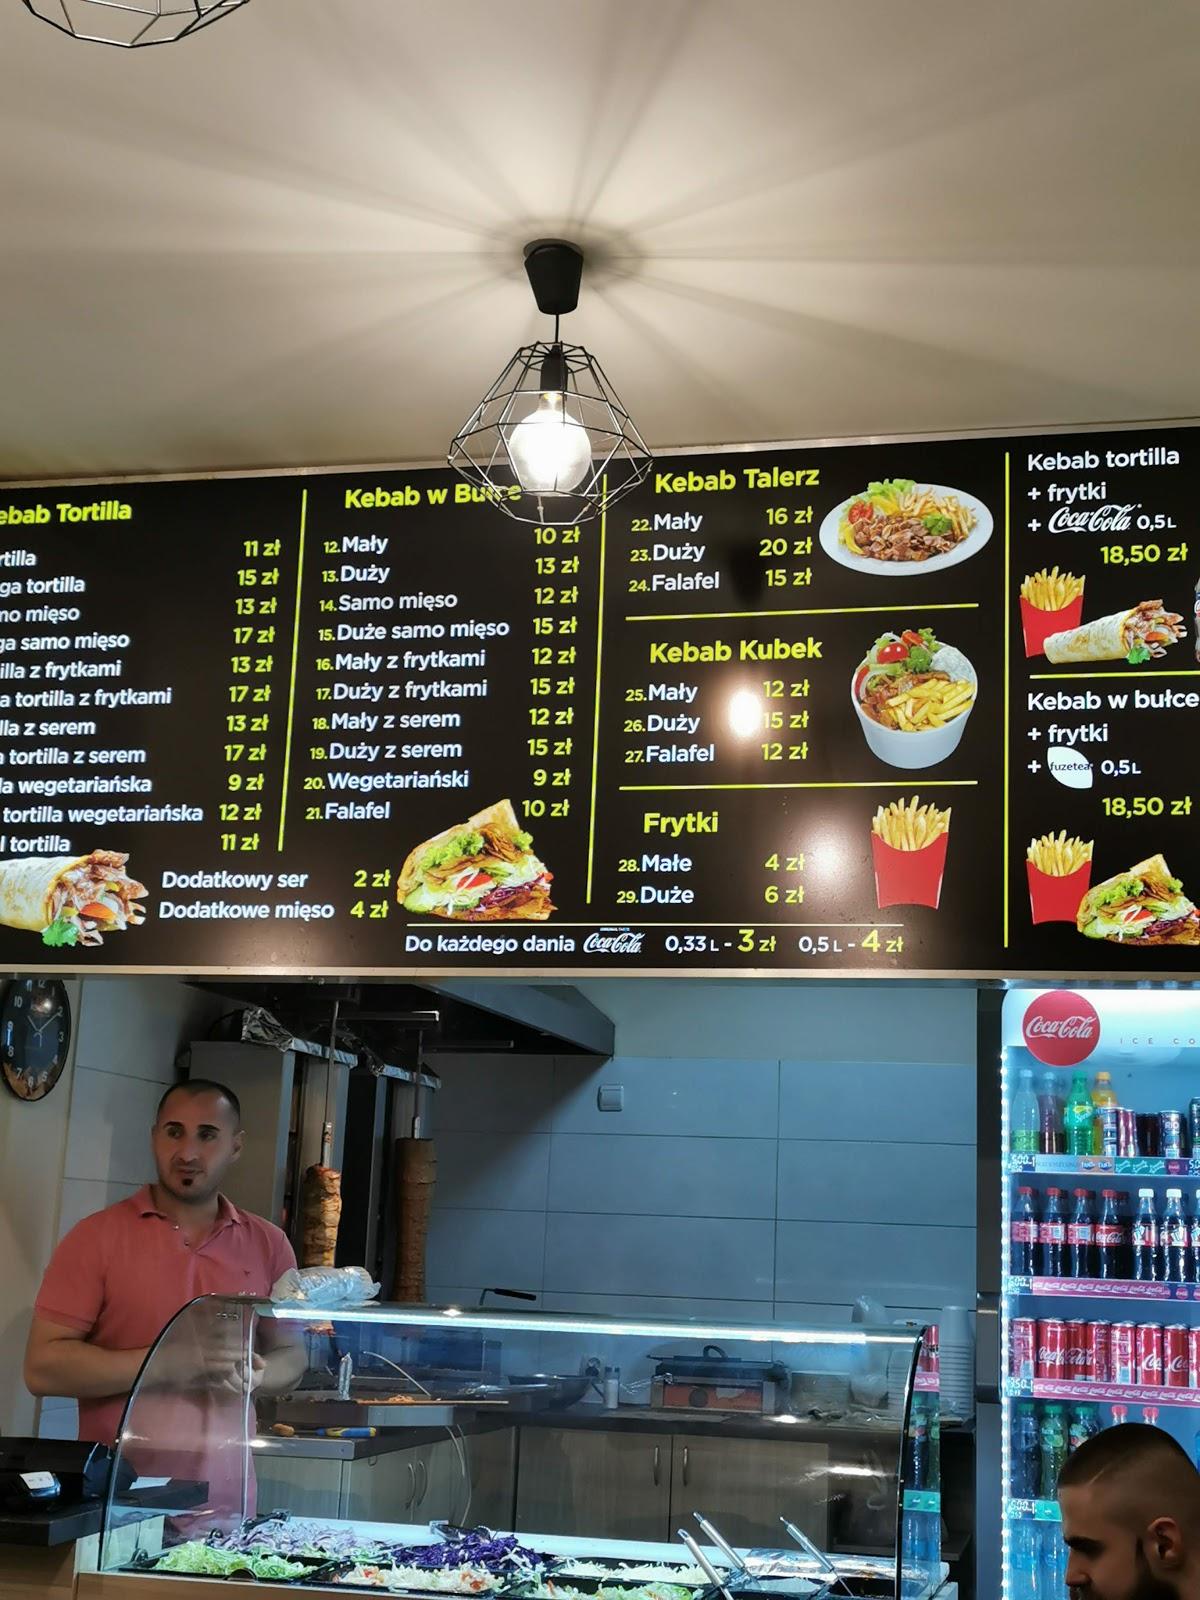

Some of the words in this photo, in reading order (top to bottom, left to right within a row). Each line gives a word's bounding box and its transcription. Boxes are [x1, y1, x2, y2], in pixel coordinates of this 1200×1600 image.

[1028, 451, 1099, 471] Kebab
[1106, 447, 1179, 467] tortilla
[656, 470, 736, 493] Kebab
[743, 467, 819, 488] Talerz
[345, 486, 420, 508] Kebab
[427, 489, 448, 504] w
[455, 484, 521, 503] Bue
[1048, 482, 1106, 504] frytki
[57, 500, 131, 522] Tortilla
[767, 508, 788, 525] 16
[794, 506, 813, 523] zł
[535, 528, 556, 544] 10
[562, 526, 580, 543] zł
[244, 541, 258, 556] 11
[263, 539, 281, 556] zł
[760, 539, 787, 556] 20
[794, 537, 812, 554] zł
[1101, 545, 1160, 566] 18,50
[1168, 543, 1188, 561] zł
[536, 558, 555, 574] 13
[561, 556, 579, 573] zł
[27, 576, 85, 593] tortilla
[238, 569, 256, 585] 15
[261, 568, 279, 585] zł
[766, 569, 786, 586] 15
[793, 568, 812, 585] zł
[400, 592, 457, 611] mięso
[535, 588, 554, 604] 12
[560, 586, 578, 603] zł
[26, 606, 80, 624] mięso
[236, 599, 254, 614] 13
[259, 597, 277, 613] zł
[392, 625, 444, 638] samo
[451, 620, 509, 639] mięso
[533, 618, 553, 634] 15
[559, 616, 577, 633] zł
[21, 636, 70, 650] samo
[75, 632, 130, 651] mięso
[234, 627, 253, 643] 17
[257, 626, 275, 643] zł
[403, 650, 485, 671] frytkami
[532, 648, 552, 664] 12
[558, 647, 576, 663] zł
[651, 641, 732, 663] Kebab
[740, 637, 822, 660] Kubek
[45, 660, 121, 680] frytkami
[231, 657, 250, 673] 13
[255, 655, 273, 672] zł
[15, 690, 74, 707] tortilla
[95, 687, 171, 708] frytkami
[229, 686, 248, 702] 17
[253, 685, 271, 701] zł
[405, 679, 487, 700] frytkami
[531, 678, 550, 695] 15
[556, 677, 575, 694] zł
[763, 680, 784, 697] 12
[791, 679, 809, 696] zł
[1028, 691, 1101, 710] Kebab
[1108, 695, 1128, 708] w
[1135, 689, 1199, 708] bułce
[39, 722, 96, 735] serem
[227, 715, 246, 731] 13
[251, 714, 269, 731] zł
[400, 714, 460, 727] serem
[529, 708, 549, 725] 12
[555, 707, 574, 724] zł
[763, 712, 783, 728] 15
[790, 711, 809, 728] zł
[1048, 724, 1107, 745] frytki
[9, 748, 69, 765] tortilla
[89, 750, 145, 763] serem
[225, 745, 244, 761] 17
[248, 744, 266, 760] zł
[401, 744, 462, 758] serem
[528, 739, 548, 755] 15
[554, 738, 572, 755] zł
[789, 742, 808, 759] zł
[1050, 761, 1090, 771] fuzetea
[18, 776, 152, 796] wegetariańska
[229, 774, 241, 791] 9
[246, 774, 264, 790] zł
[328, 770, 468, 792] Wegetariański
[534, 769, 546, 786] 9
[552, 768, 571, 785] zł
[3, 806, 63, 822] tortilla
[68, 804, 203, 825] wegetariańska
[220, 804, 239, 820] 12
[244, 803, 262, 820] zł
[522, 800, 545, 816] 10
[551, 799, 569, 816] zł
[1102, 797, 1163, 818] 18,50
[1171, 796, 1192, 815] zł
[644, 812, 718, 837] Frytki
[10, 835, 70, 852] tortilla
[221, 834, 236, 850] 11
[241, 833, 259, 850] zł
[765, 854, 779, 870] 4
[162, 871, 273, 891] Dodatkowy
[277, 874, 308, 887] ser
[354, 870, 367, 887] 2
[372, 870, 391, 887] zł
[765, 886, 778, 903] 6
[159, 901, 270, 918] Dodatkowe
[275, 901, 334, 921] mięso
[351, 901, 364, 918] 4
[370, 900, 388, 918] zł
[406, 936, 432, 951] Do
[437, 935, 518, 954] każdego
[523, 935, 575, 951] dania
[666, 936, 706, 953] 0,33
[738, 929, 754, 951] 3
[759, 936, 776, 951] zł
[799, 936, 829, 954] 0,5
[862, 930, 881, 952] 4
[886, 936, 903, 952] zł
